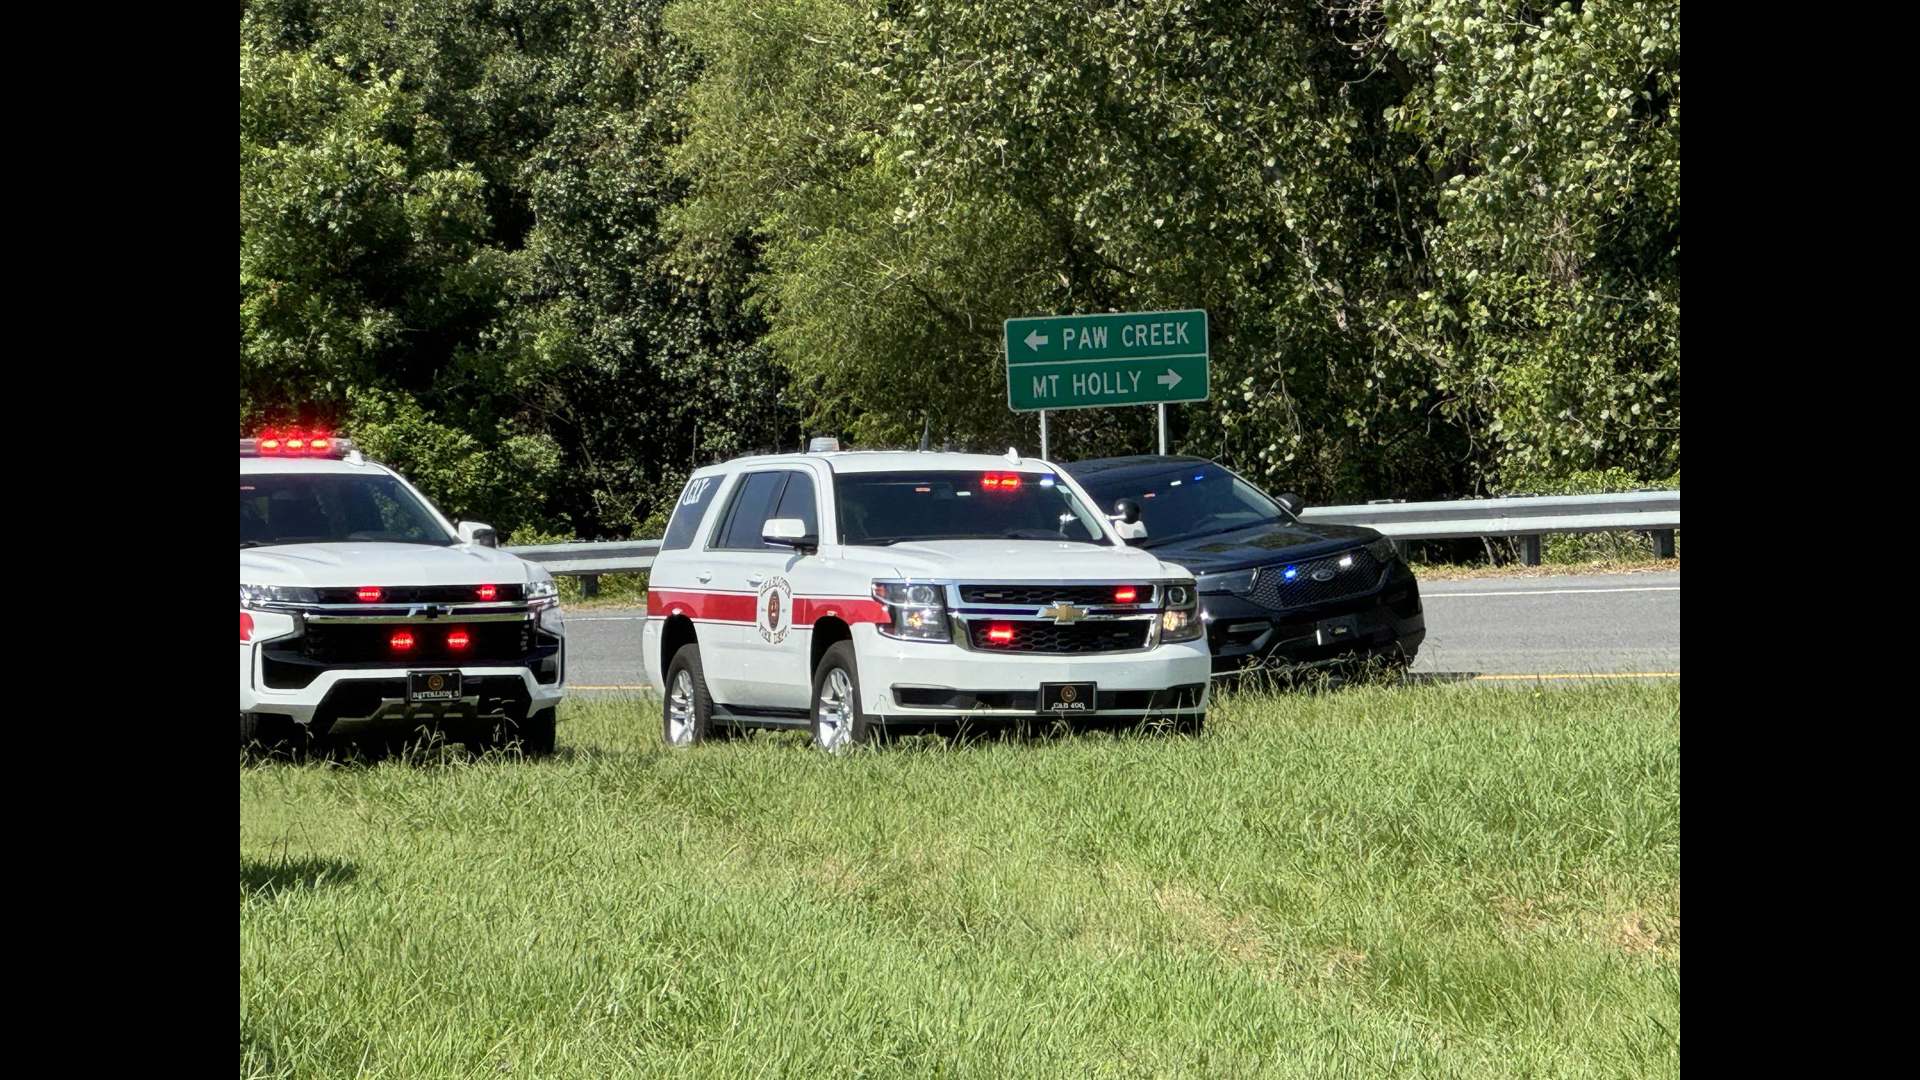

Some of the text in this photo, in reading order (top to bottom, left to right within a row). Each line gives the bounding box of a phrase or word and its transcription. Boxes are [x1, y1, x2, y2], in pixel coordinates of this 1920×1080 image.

[1063, 321, 1190, 350] PAW CREEK
[1032, 370, 1142, 399] MT HOLLY
